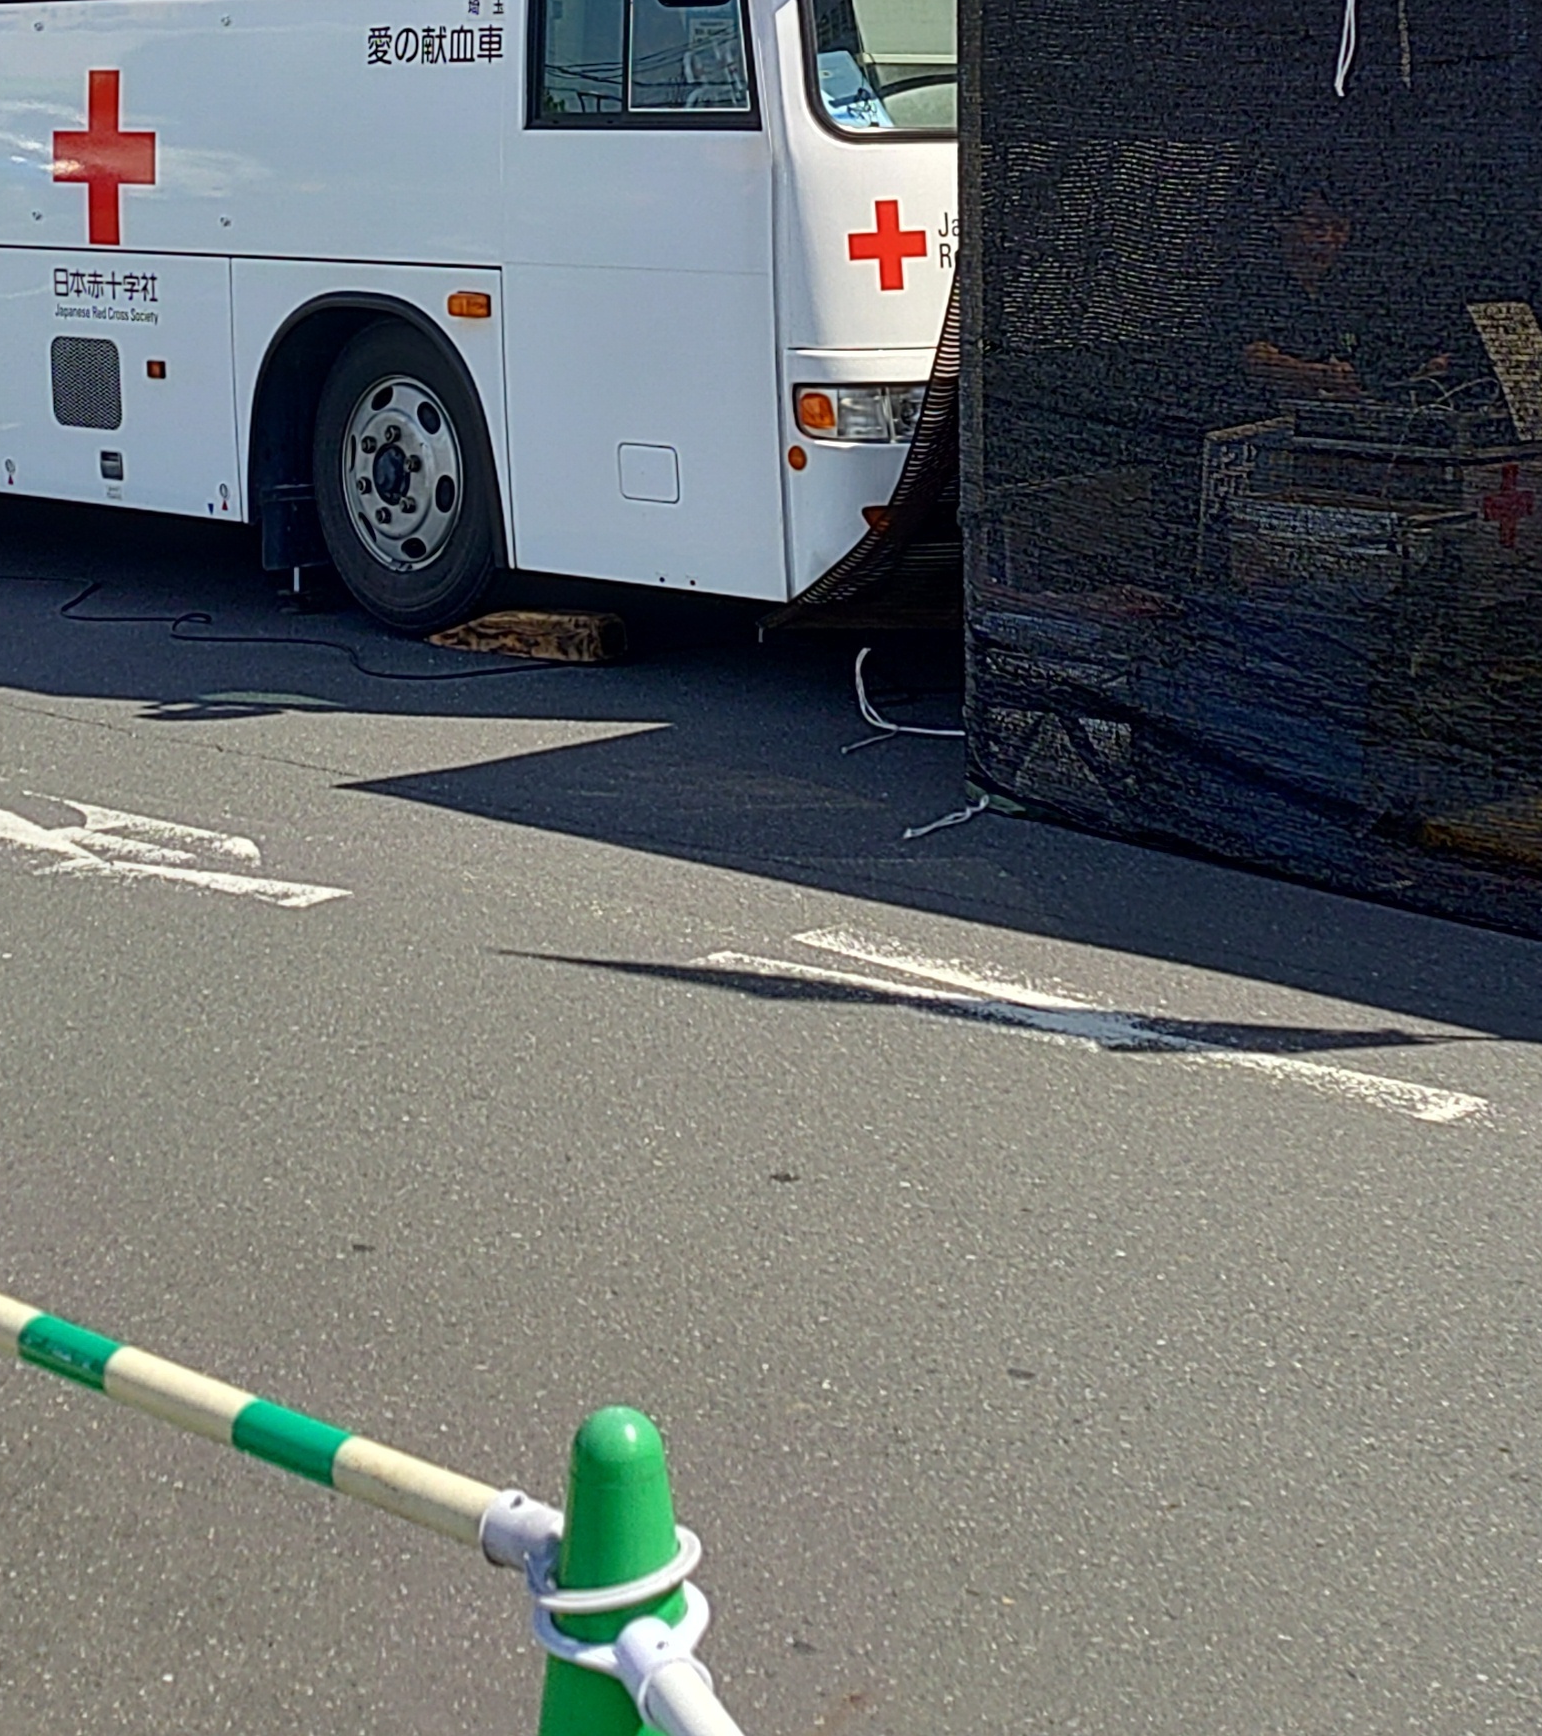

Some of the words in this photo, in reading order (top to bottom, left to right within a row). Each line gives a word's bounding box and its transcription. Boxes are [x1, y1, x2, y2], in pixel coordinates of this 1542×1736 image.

[367, 23, 504, 66] 愛の献血車
[54, 267, 158, 302] 日本赤十字社
[55, 303, 90, 319] Japanese
[91, 305, 107, 320] Red
[107, 307, 130, 322] Cross
[130, 308, 158, 325] Society
